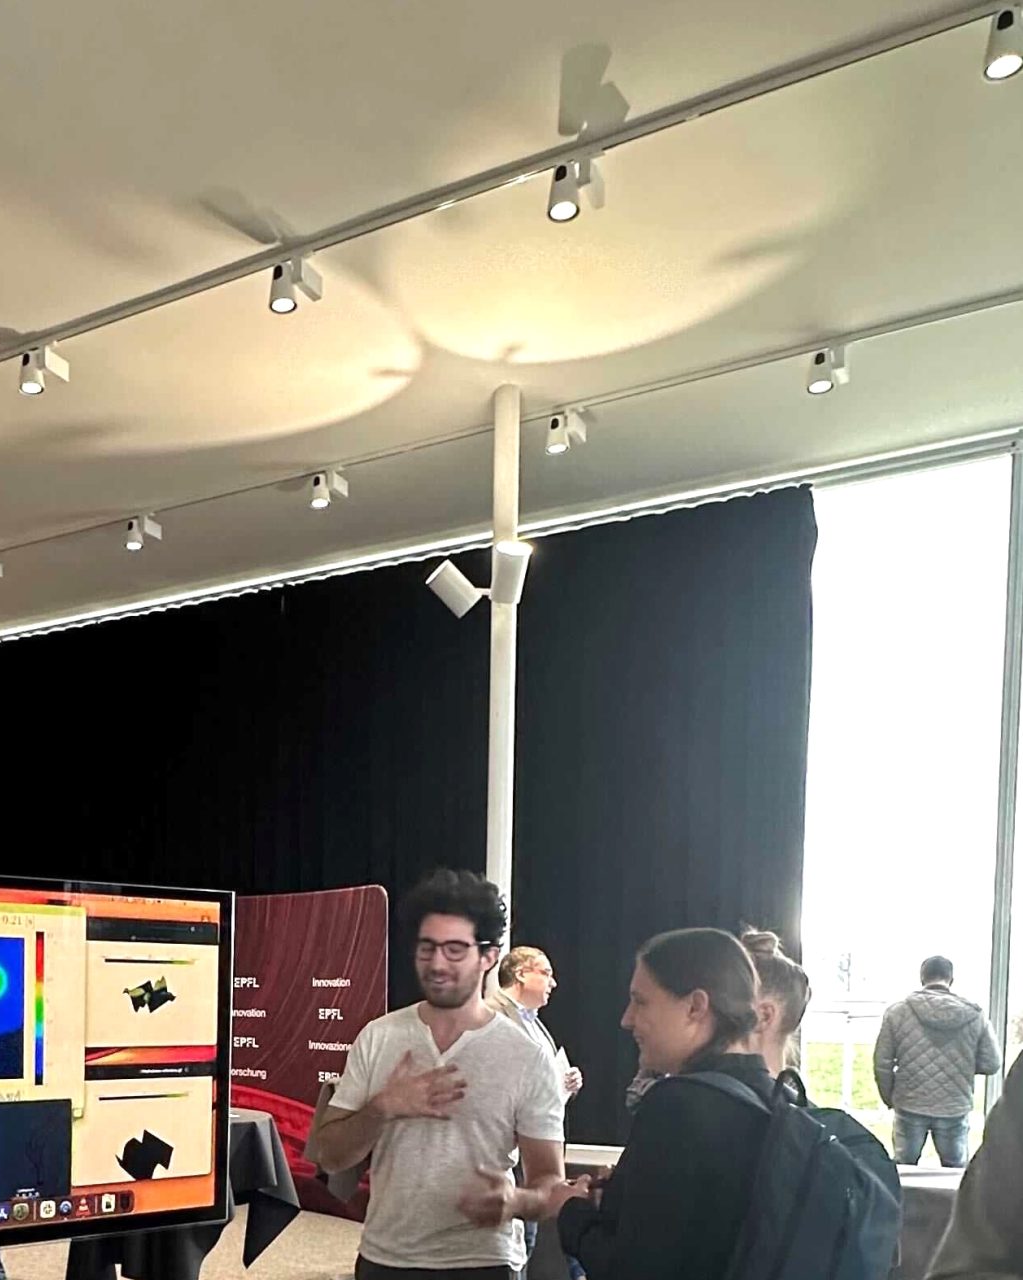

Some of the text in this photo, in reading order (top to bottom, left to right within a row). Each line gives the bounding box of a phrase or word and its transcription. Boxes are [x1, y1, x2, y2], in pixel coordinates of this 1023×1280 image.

[233, 977, 259, 988] EPFL
[312, 977, 351, 987] Innovation
[318, 1008, 343, 1020] EPFL
[233, 1037, 259, 1048] EPFL
